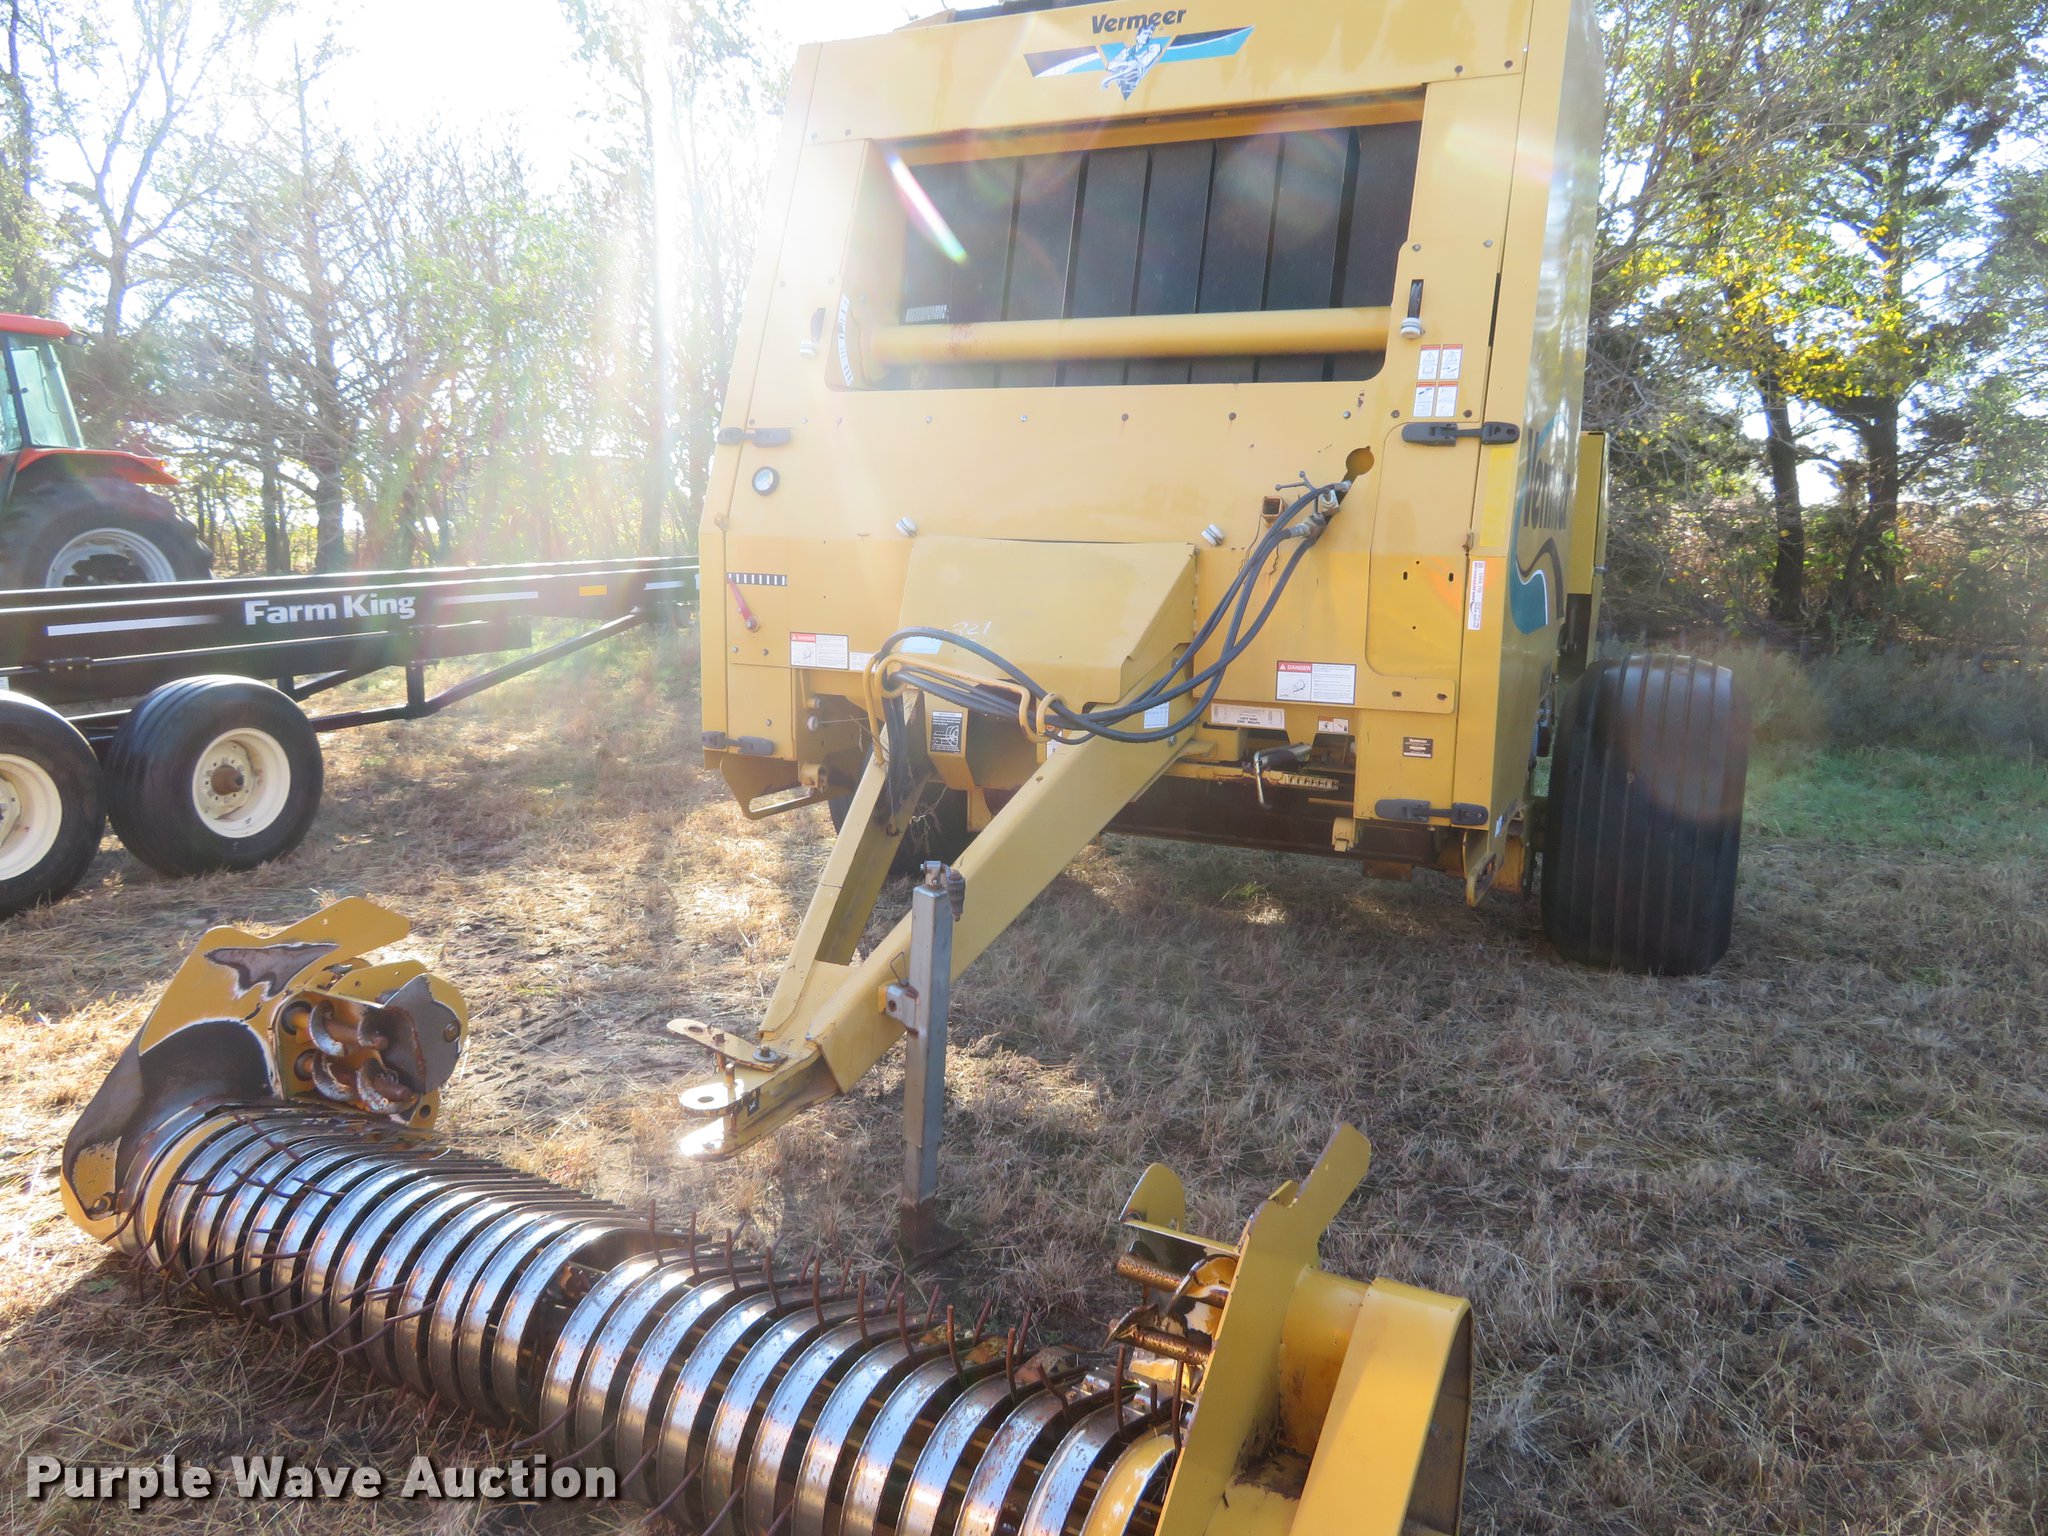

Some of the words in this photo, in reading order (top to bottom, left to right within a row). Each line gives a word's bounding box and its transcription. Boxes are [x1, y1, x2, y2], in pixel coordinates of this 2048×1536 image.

[1091, 9, 1187, 34] Vermeer
[244, 600, 337, 625] Farm
[342, 593, 416, 619] King
[1287, 664, 1311, 672] DANGER
